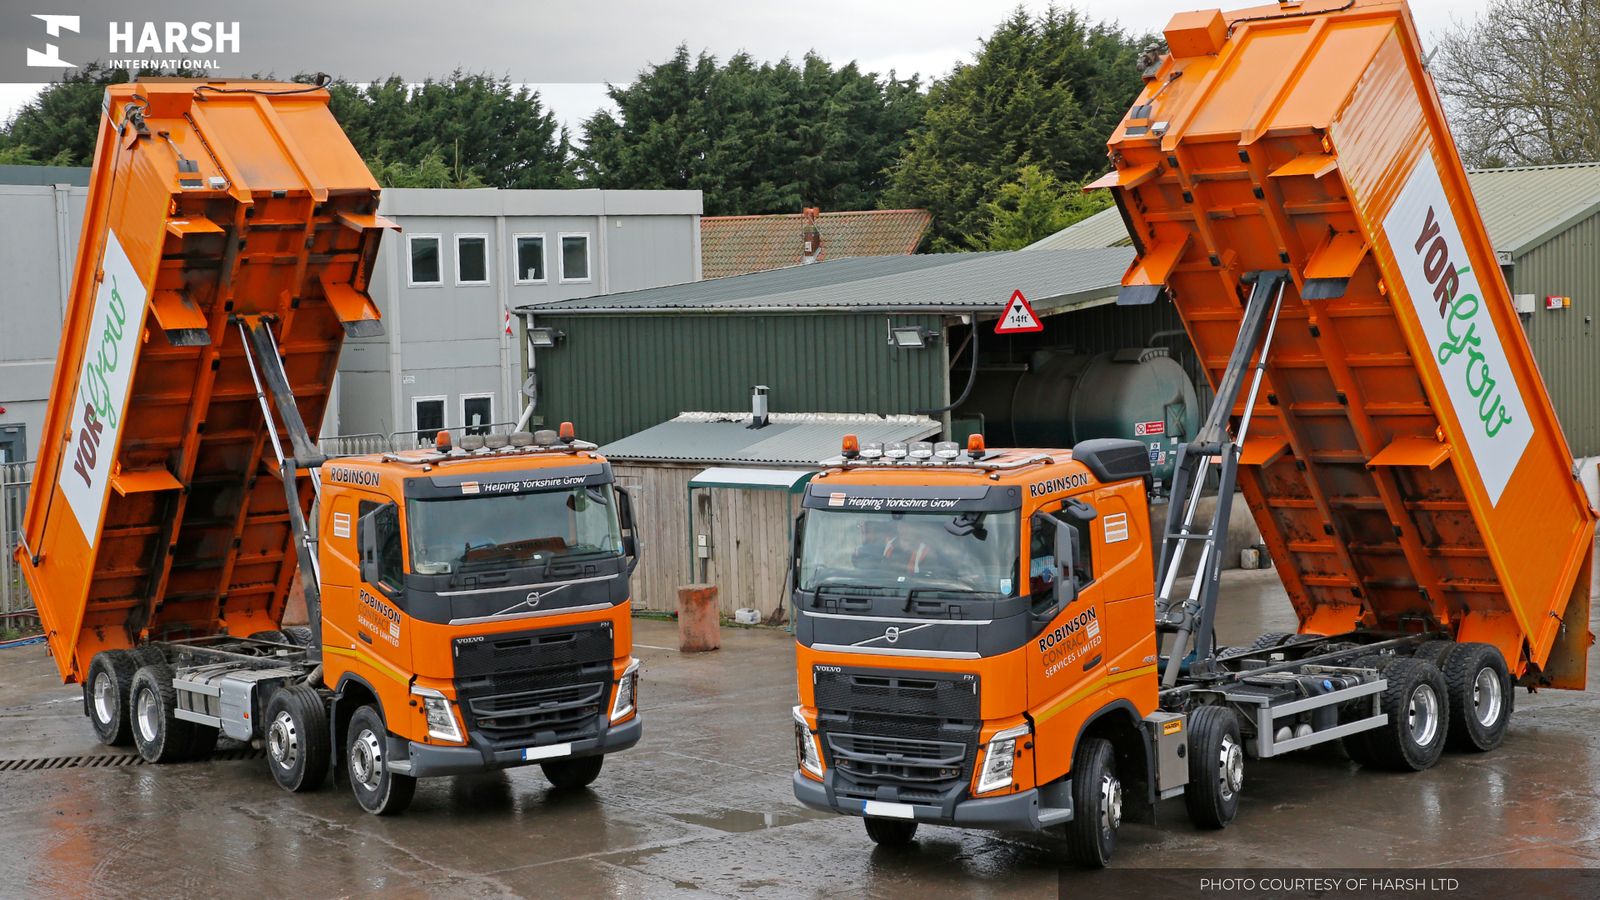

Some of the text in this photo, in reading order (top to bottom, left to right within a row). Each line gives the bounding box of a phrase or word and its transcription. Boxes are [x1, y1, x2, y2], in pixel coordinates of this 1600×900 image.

[1010, 315, 1028, 323] 14ft
[331, 467, 380, 487] ROBINSON
[522, 477, 561, 488] Yorkshire
[1030, 472, 1088, 497] ROBINSON
[885, 497, 928, 508] Yorkshire
[359, 589, 401, 625] ROBINSON
[456, 636, 485, 644] VOLVO
[1038, 606, 1097, 653] ROBINSON
[1042, 630, 1087, 668] CONTRACT
[1045, 635, 1102, 679] SERVICES LIMITED
